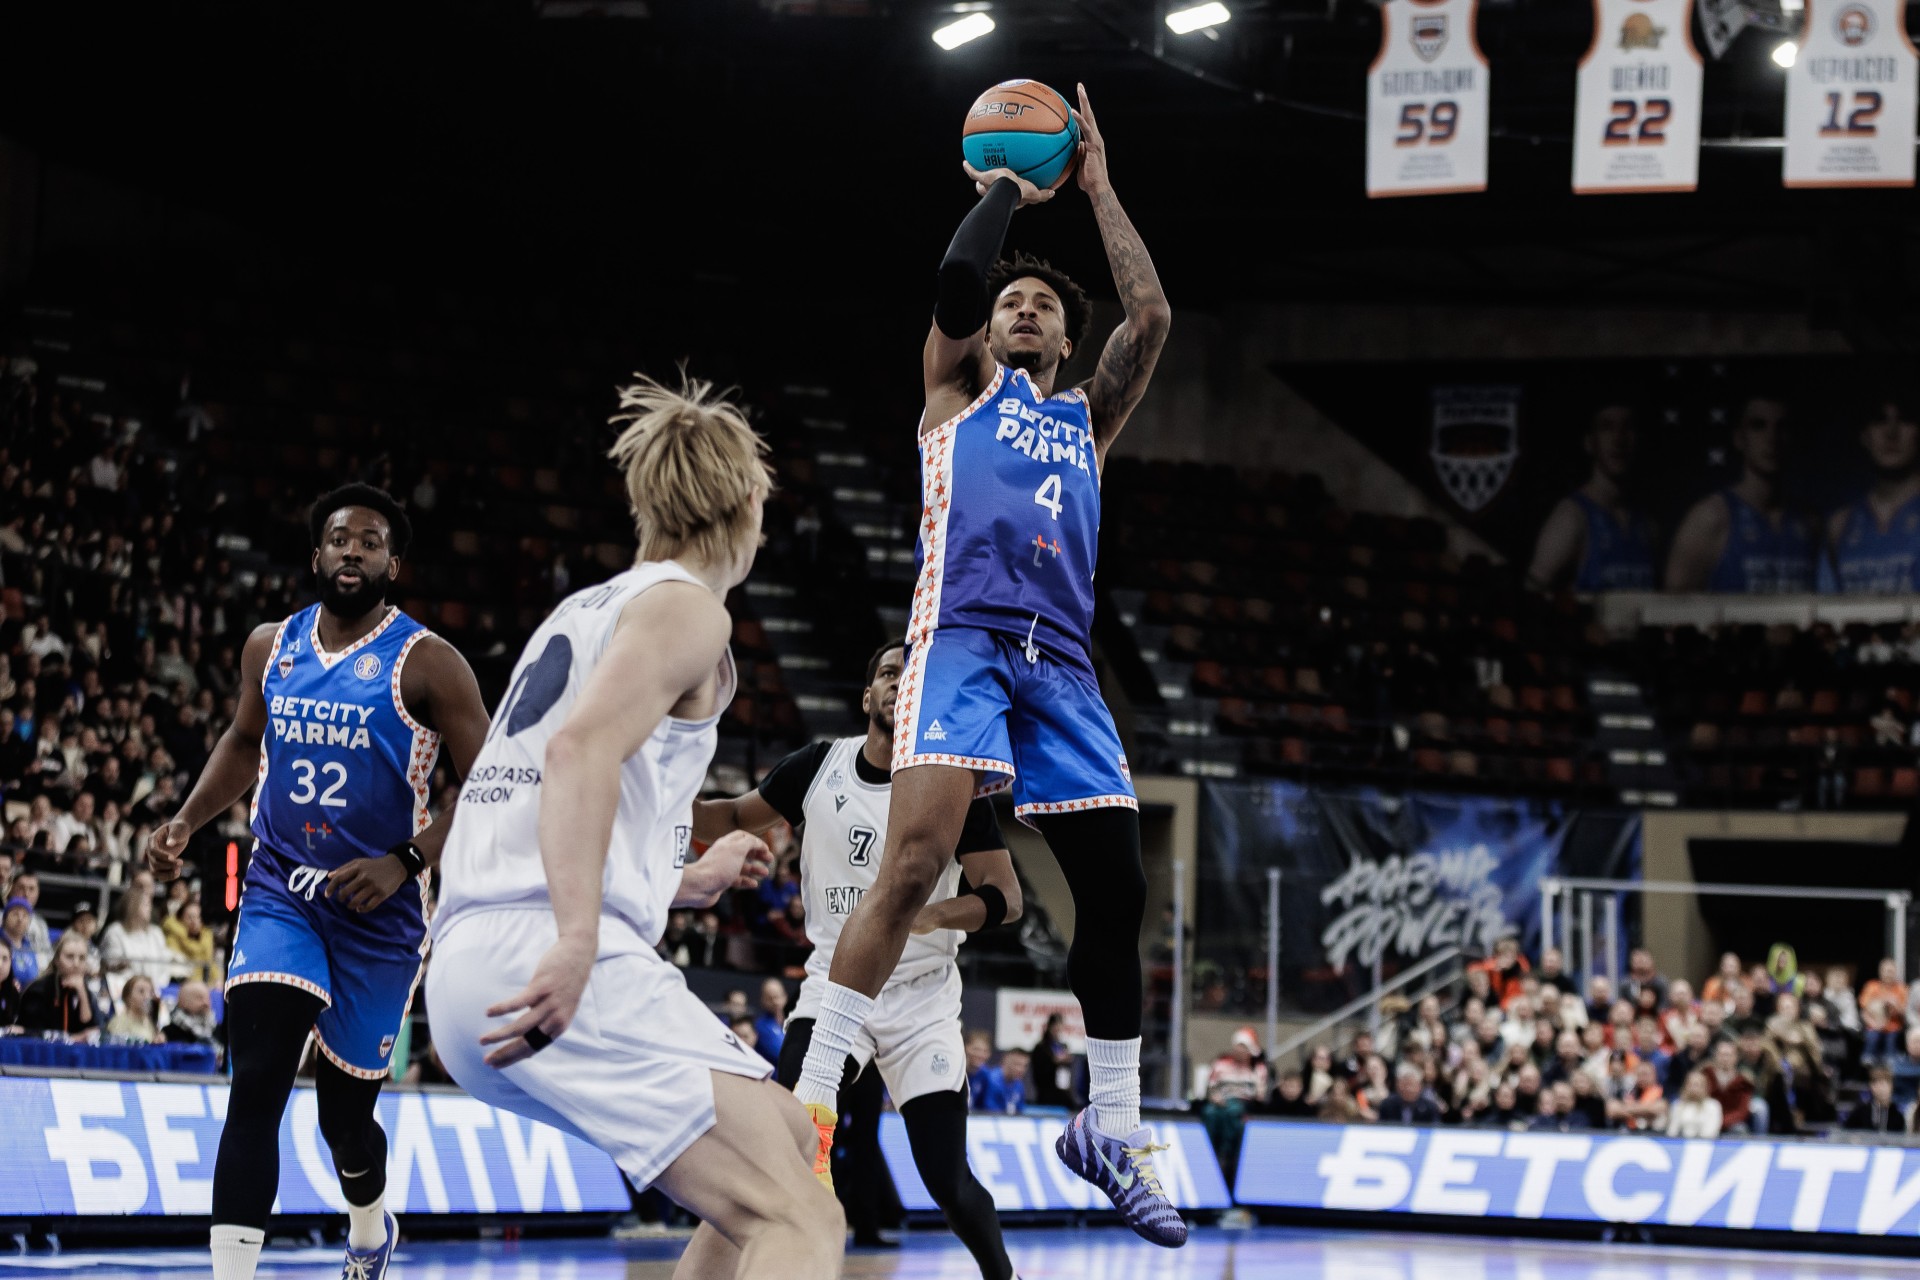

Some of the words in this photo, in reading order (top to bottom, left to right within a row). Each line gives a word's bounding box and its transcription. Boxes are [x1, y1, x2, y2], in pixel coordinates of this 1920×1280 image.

[1395, 101, 1460, 148] 59
[1602, 98, 1671, 146] 22
[1818, 91, 1884, 138] 12
[983, 154, 1008, 167] FIBA
[995, 416, 1091, 478] PARMA
[1034, 474, 1063, 521] 4
[270, 695, 376, 726] BETCITY
[272, 718, 371, 750] PARMA
[923, 731, 948, 742] PEAK
[289, 759, 348, 807] 32
[849, 825, 876, 866] 7
[825, 886, 869, 914] ENI
